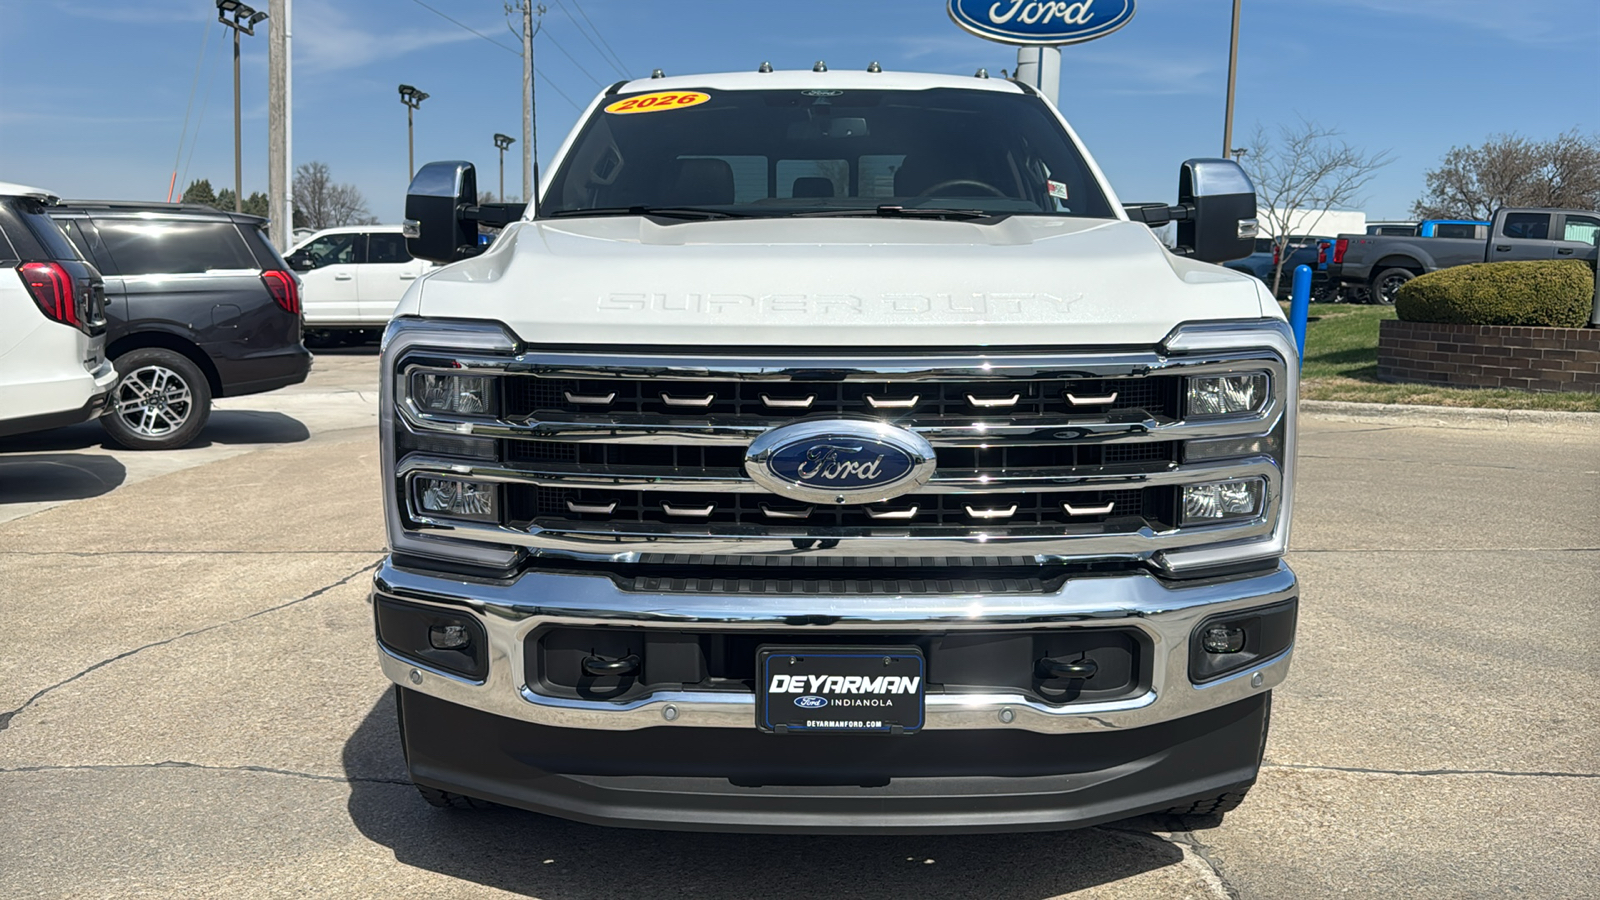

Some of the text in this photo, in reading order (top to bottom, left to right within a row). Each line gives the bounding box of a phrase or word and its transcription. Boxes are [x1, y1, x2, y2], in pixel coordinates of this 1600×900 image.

[614, 93, 700, 112] 2026
[597, 292, 1084, 314] SUPER DUTY
[797, 444, 885, 480] Ford
[769, 674, 921, 695] DEYARMAN
[800, 696, 893, 707] Ford INDIANOLA
[806, 720, 882, 728] DEYARMANFORD.COM
